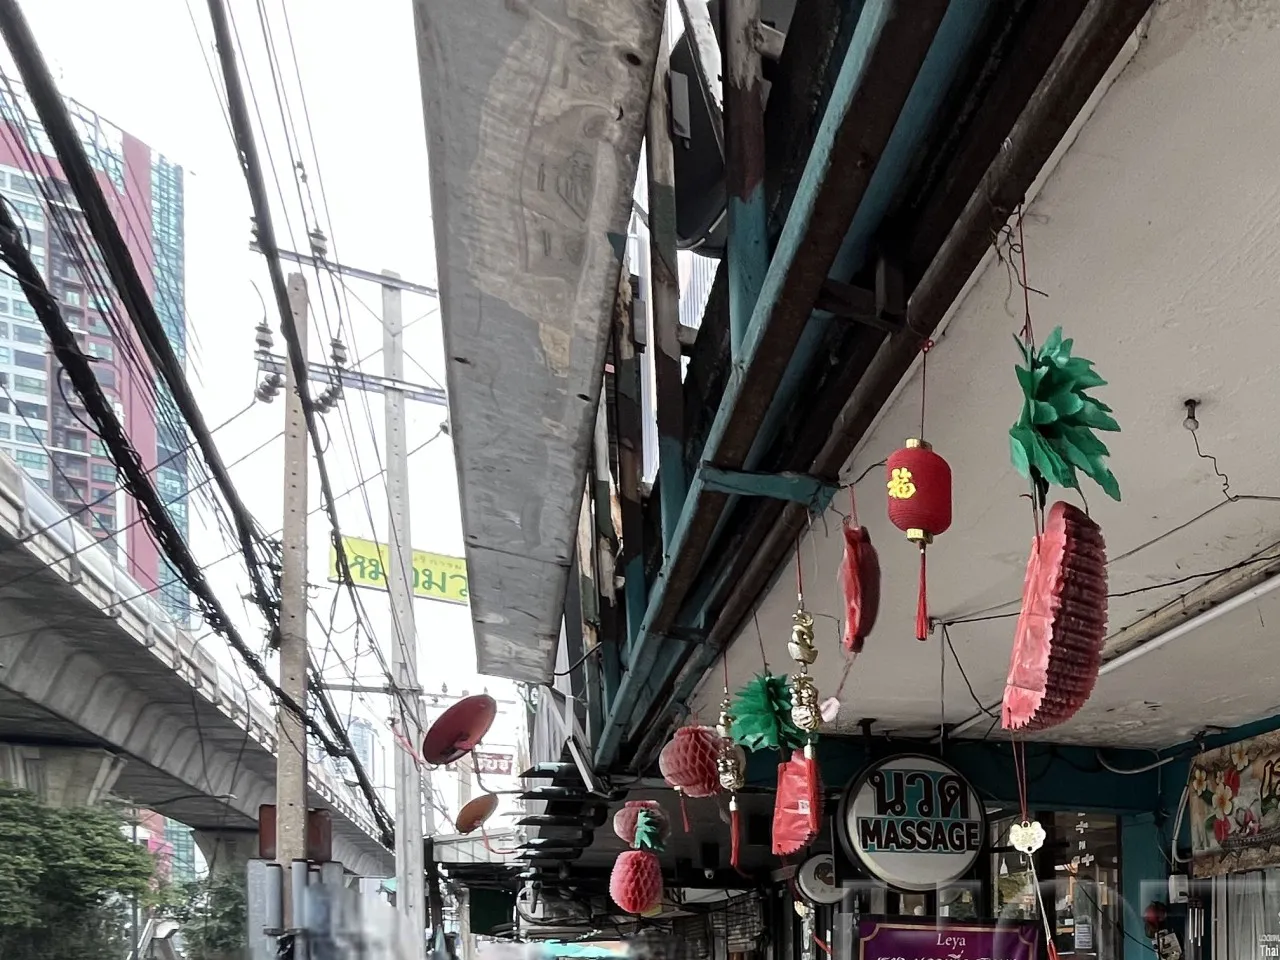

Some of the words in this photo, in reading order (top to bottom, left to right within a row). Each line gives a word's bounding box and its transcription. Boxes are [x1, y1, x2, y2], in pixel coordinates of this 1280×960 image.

[887, 467, 916, 499] 福
[869, 769, 969, 819] นวด
[861, 820, 980, 852] MASSAGE
[937, 933, 966, 950] Leya
[1260, 945, 1279, 956] Thai
